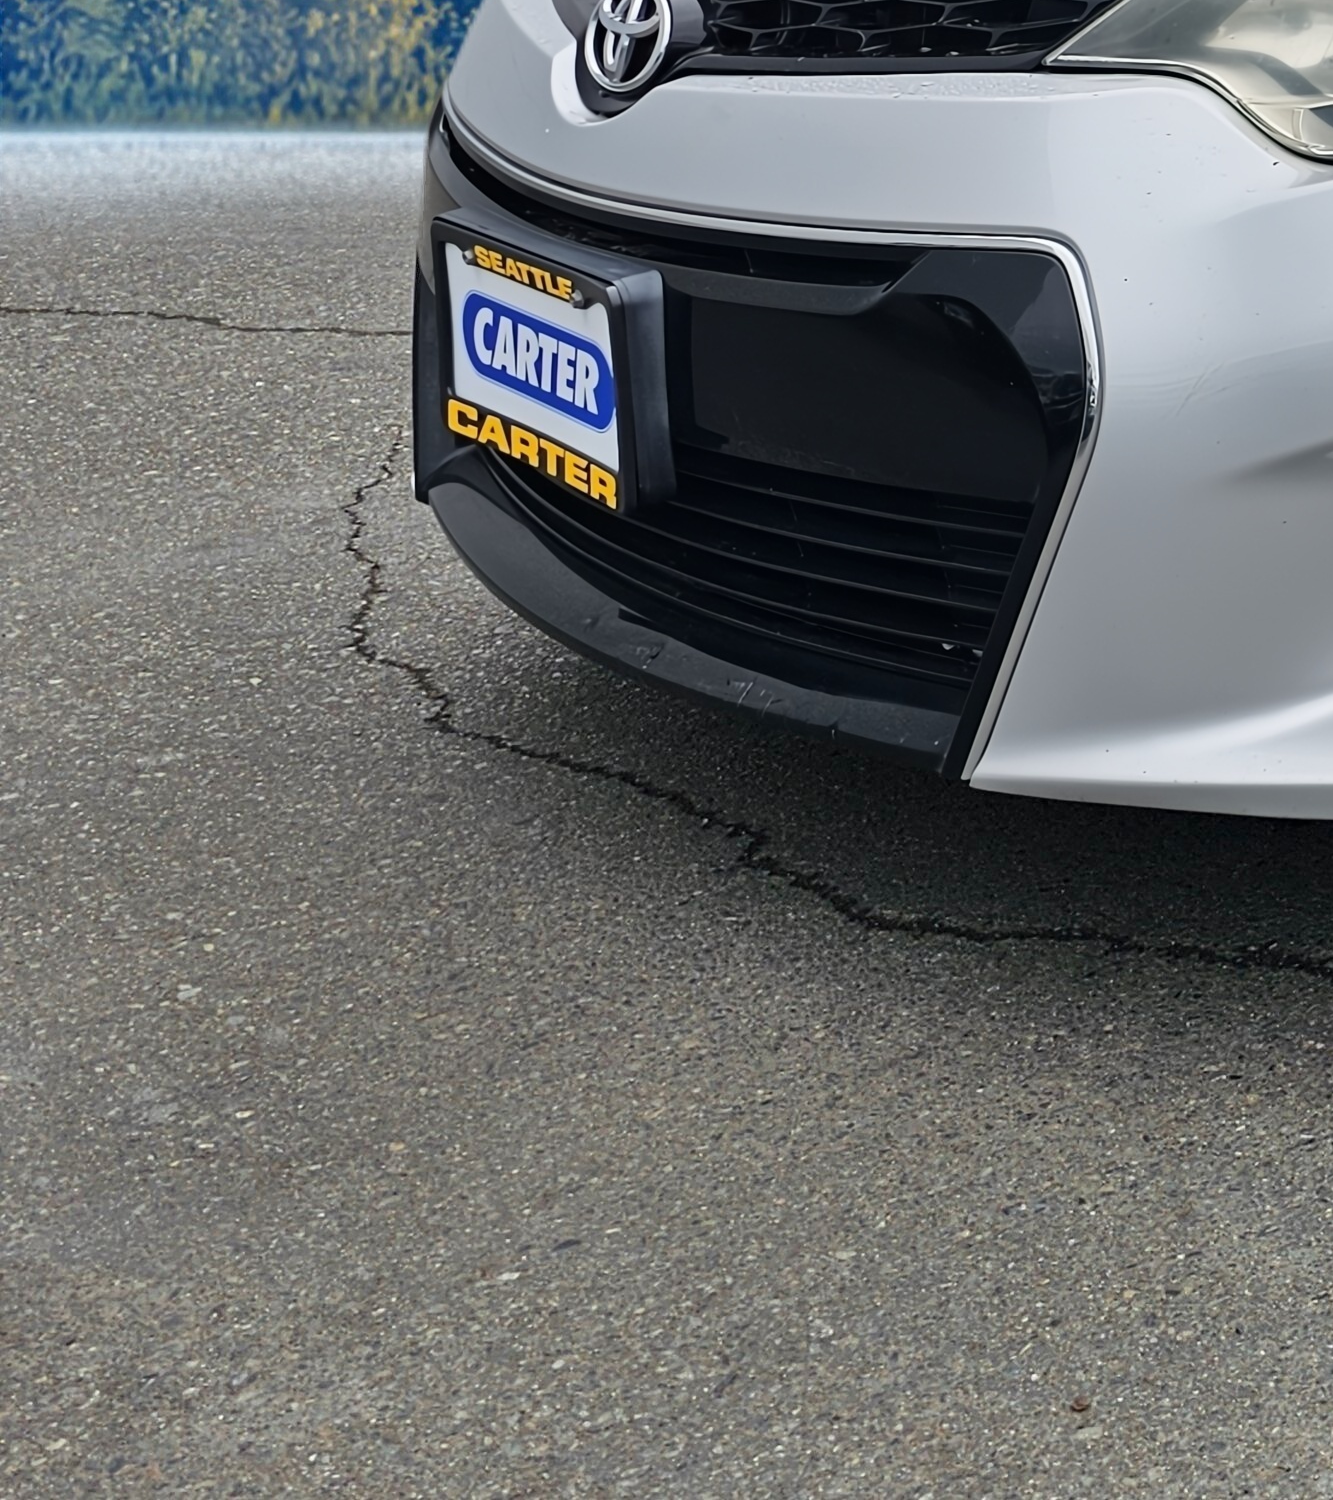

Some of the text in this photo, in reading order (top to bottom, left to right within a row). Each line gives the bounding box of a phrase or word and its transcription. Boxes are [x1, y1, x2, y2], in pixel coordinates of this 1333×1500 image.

[473, 245, 573, 299] SEATTLE
[473, 306, 600, 417] CARTER
[447, 398, 618, 511] CARTER
